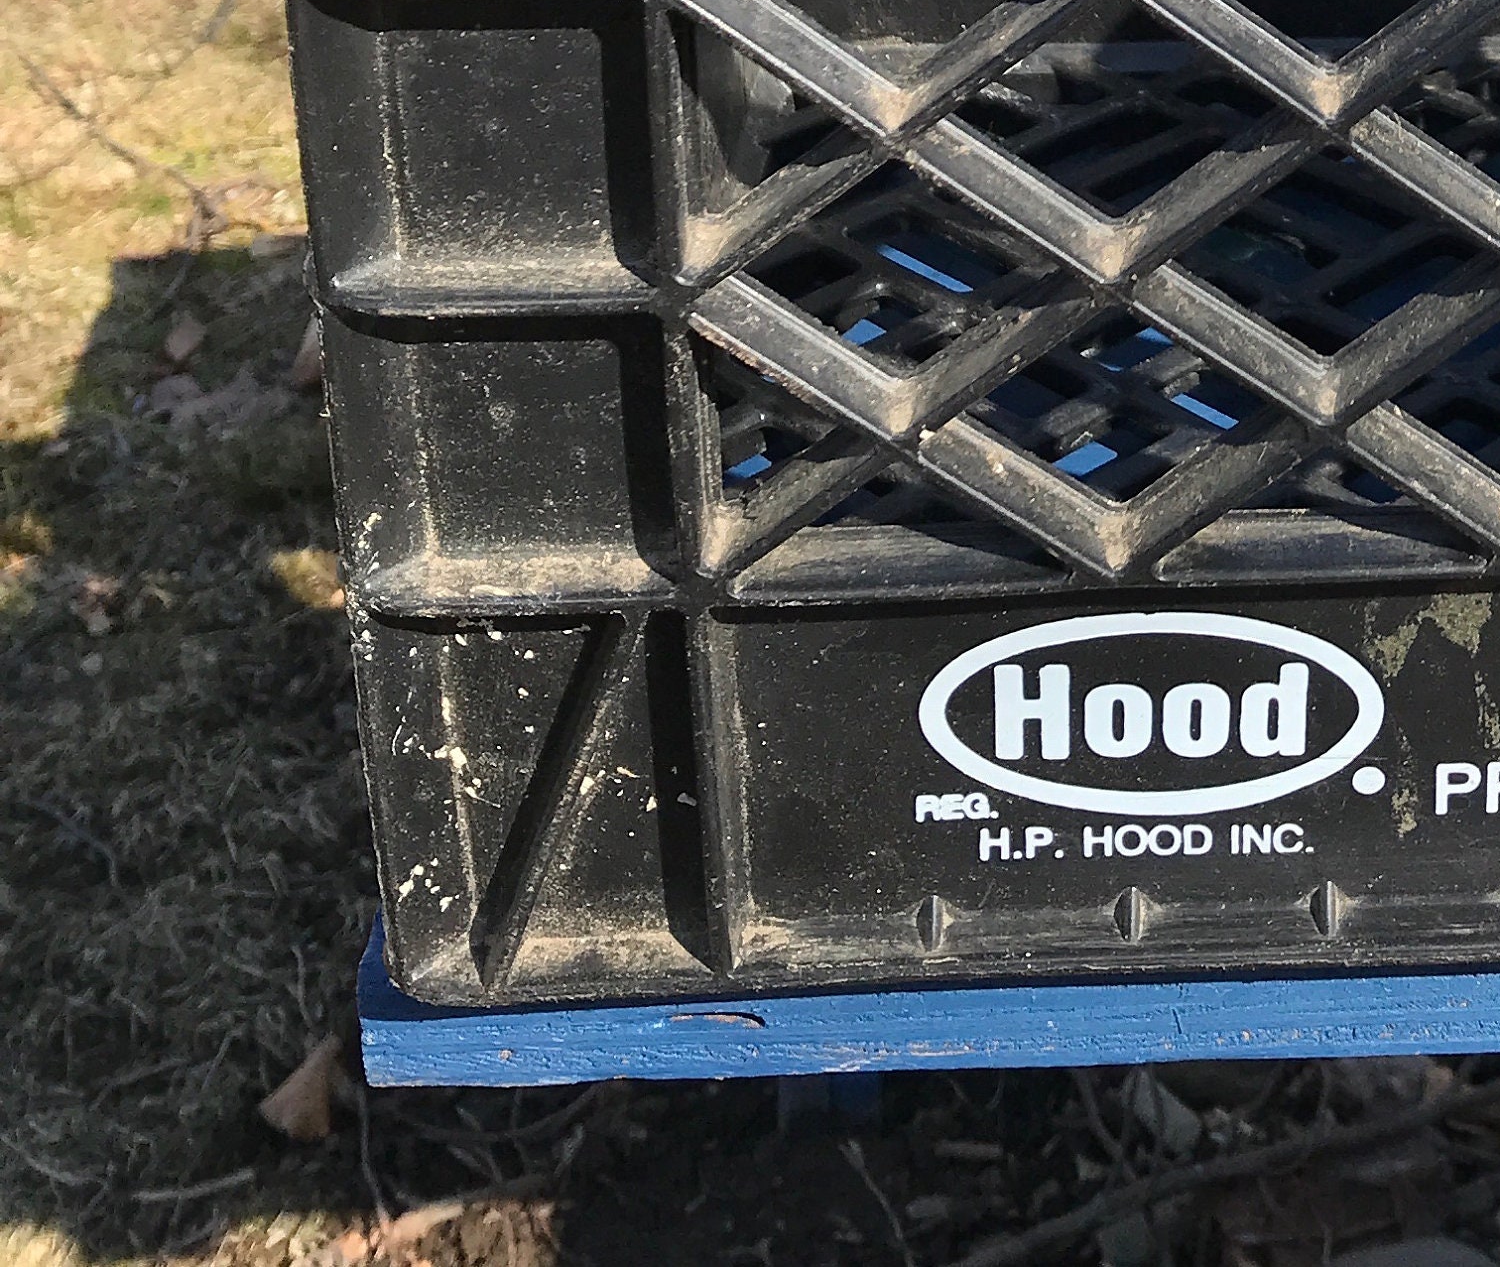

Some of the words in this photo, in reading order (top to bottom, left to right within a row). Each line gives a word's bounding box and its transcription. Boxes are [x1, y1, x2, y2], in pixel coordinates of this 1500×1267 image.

[993, 662, 1309, 761] Hood
[915, 792, 999, 823] REG.
[979, 826, 1065, 861] H.P.
[1083, 824, 1213, 858] HOOD
[1230, 823, 1315, 855] INC.
